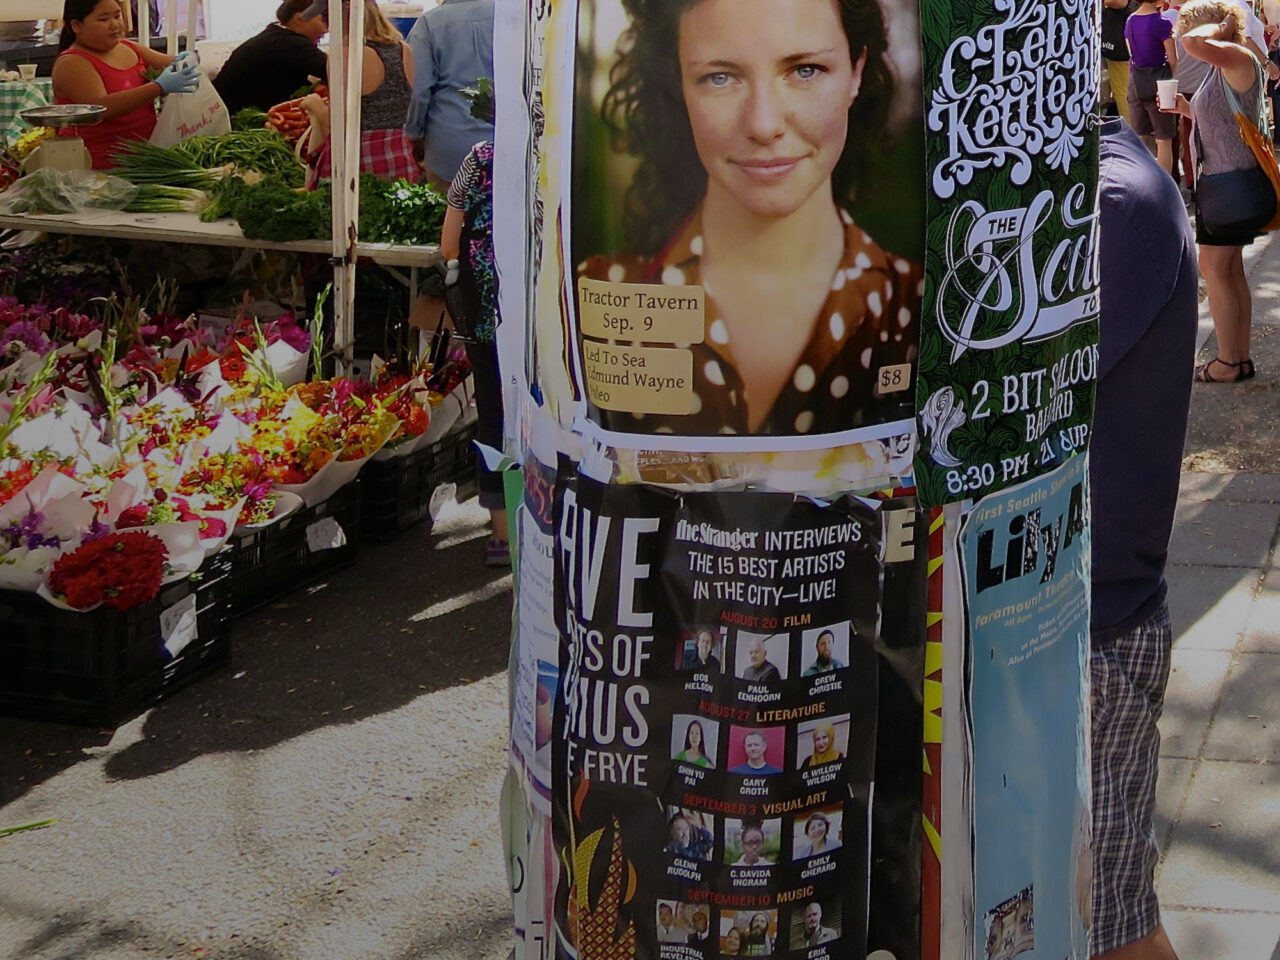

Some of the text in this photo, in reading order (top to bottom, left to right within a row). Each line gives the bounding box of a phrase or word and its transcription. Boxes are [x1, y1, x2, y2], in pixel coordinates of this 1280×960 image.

[929, 60, 1068, 180] Kettle
[988, 215, 1018, 236] THE
[582, 287, 698, 310] Tractor Tavern
[603, 312, 653, 334] Sep. 9
[602, 351, 618, 365] To
[622, 353, 646, 368] Sea
[633, 373, 684, 392] Wayne
[881, 369, 903, 388] $8
[972, 379, 991, 420] 2
[1002, 368, 1047, 415] BIT
[946, 462, 995, 494] 8:30
[1001, 452, 1029, 482] PM
[1006, 489, 1048, 514] Seattle
[764, 521, 862, 552] INTERVIEWS
[975, 506, 1064, 595] Lily
[688, 549, 845, 579] THE 15 BEST ARTISTS
[693, 580, 710, 600] IN
[713, 581, 745, 602] THE
[720, 611, 811, 629] AUGUST 20 FILM
[975, 593, 1042, 629] Paramount
[612, 633, 655, 678] OF
[684, 682, 714, 694] NELSON
[808, 681, 842, 696] CHRISTIE
[814, 673, 836, 686] DREW
[737, 691, 781, 703] EENHOORN
[747, 685, 769, 694] PAUL
[563, 677, 650, 748] IUS
[698, 700, 827, 723] AUGUST 27 LITERATURE
[584, 748, 649, 787] FRYE
[678, 764, 705, 780] SHIN YU
[811, 763, 842, 777] WILLOW
[743, 778, 766, 787] GARY
[806, 772, 836, 787] WILSON
[740, 787, 769, 796] GROTH
[683, 793, 747, 815] SEPTEMBER
[762, 799, 804, 815] VISUAL
[806, 791, 828, 807] ART
[674, 857, 698, 871] GLENN
[800, 862, 836, 879] GHERARD
[808, 855, 830, 869] EMILY
[667, 867, 701, 881] RUDOLPH
[730, 869, 771, 879] C. DAVIDA
[733, 878, 767, 887] INGRAM
[687, 886, 814, 906] SEPTEMBER 10 MUSIC
[660, 944, 704, 960] INDUSTRIAL
[808, 946, 827, 960] ERIK
